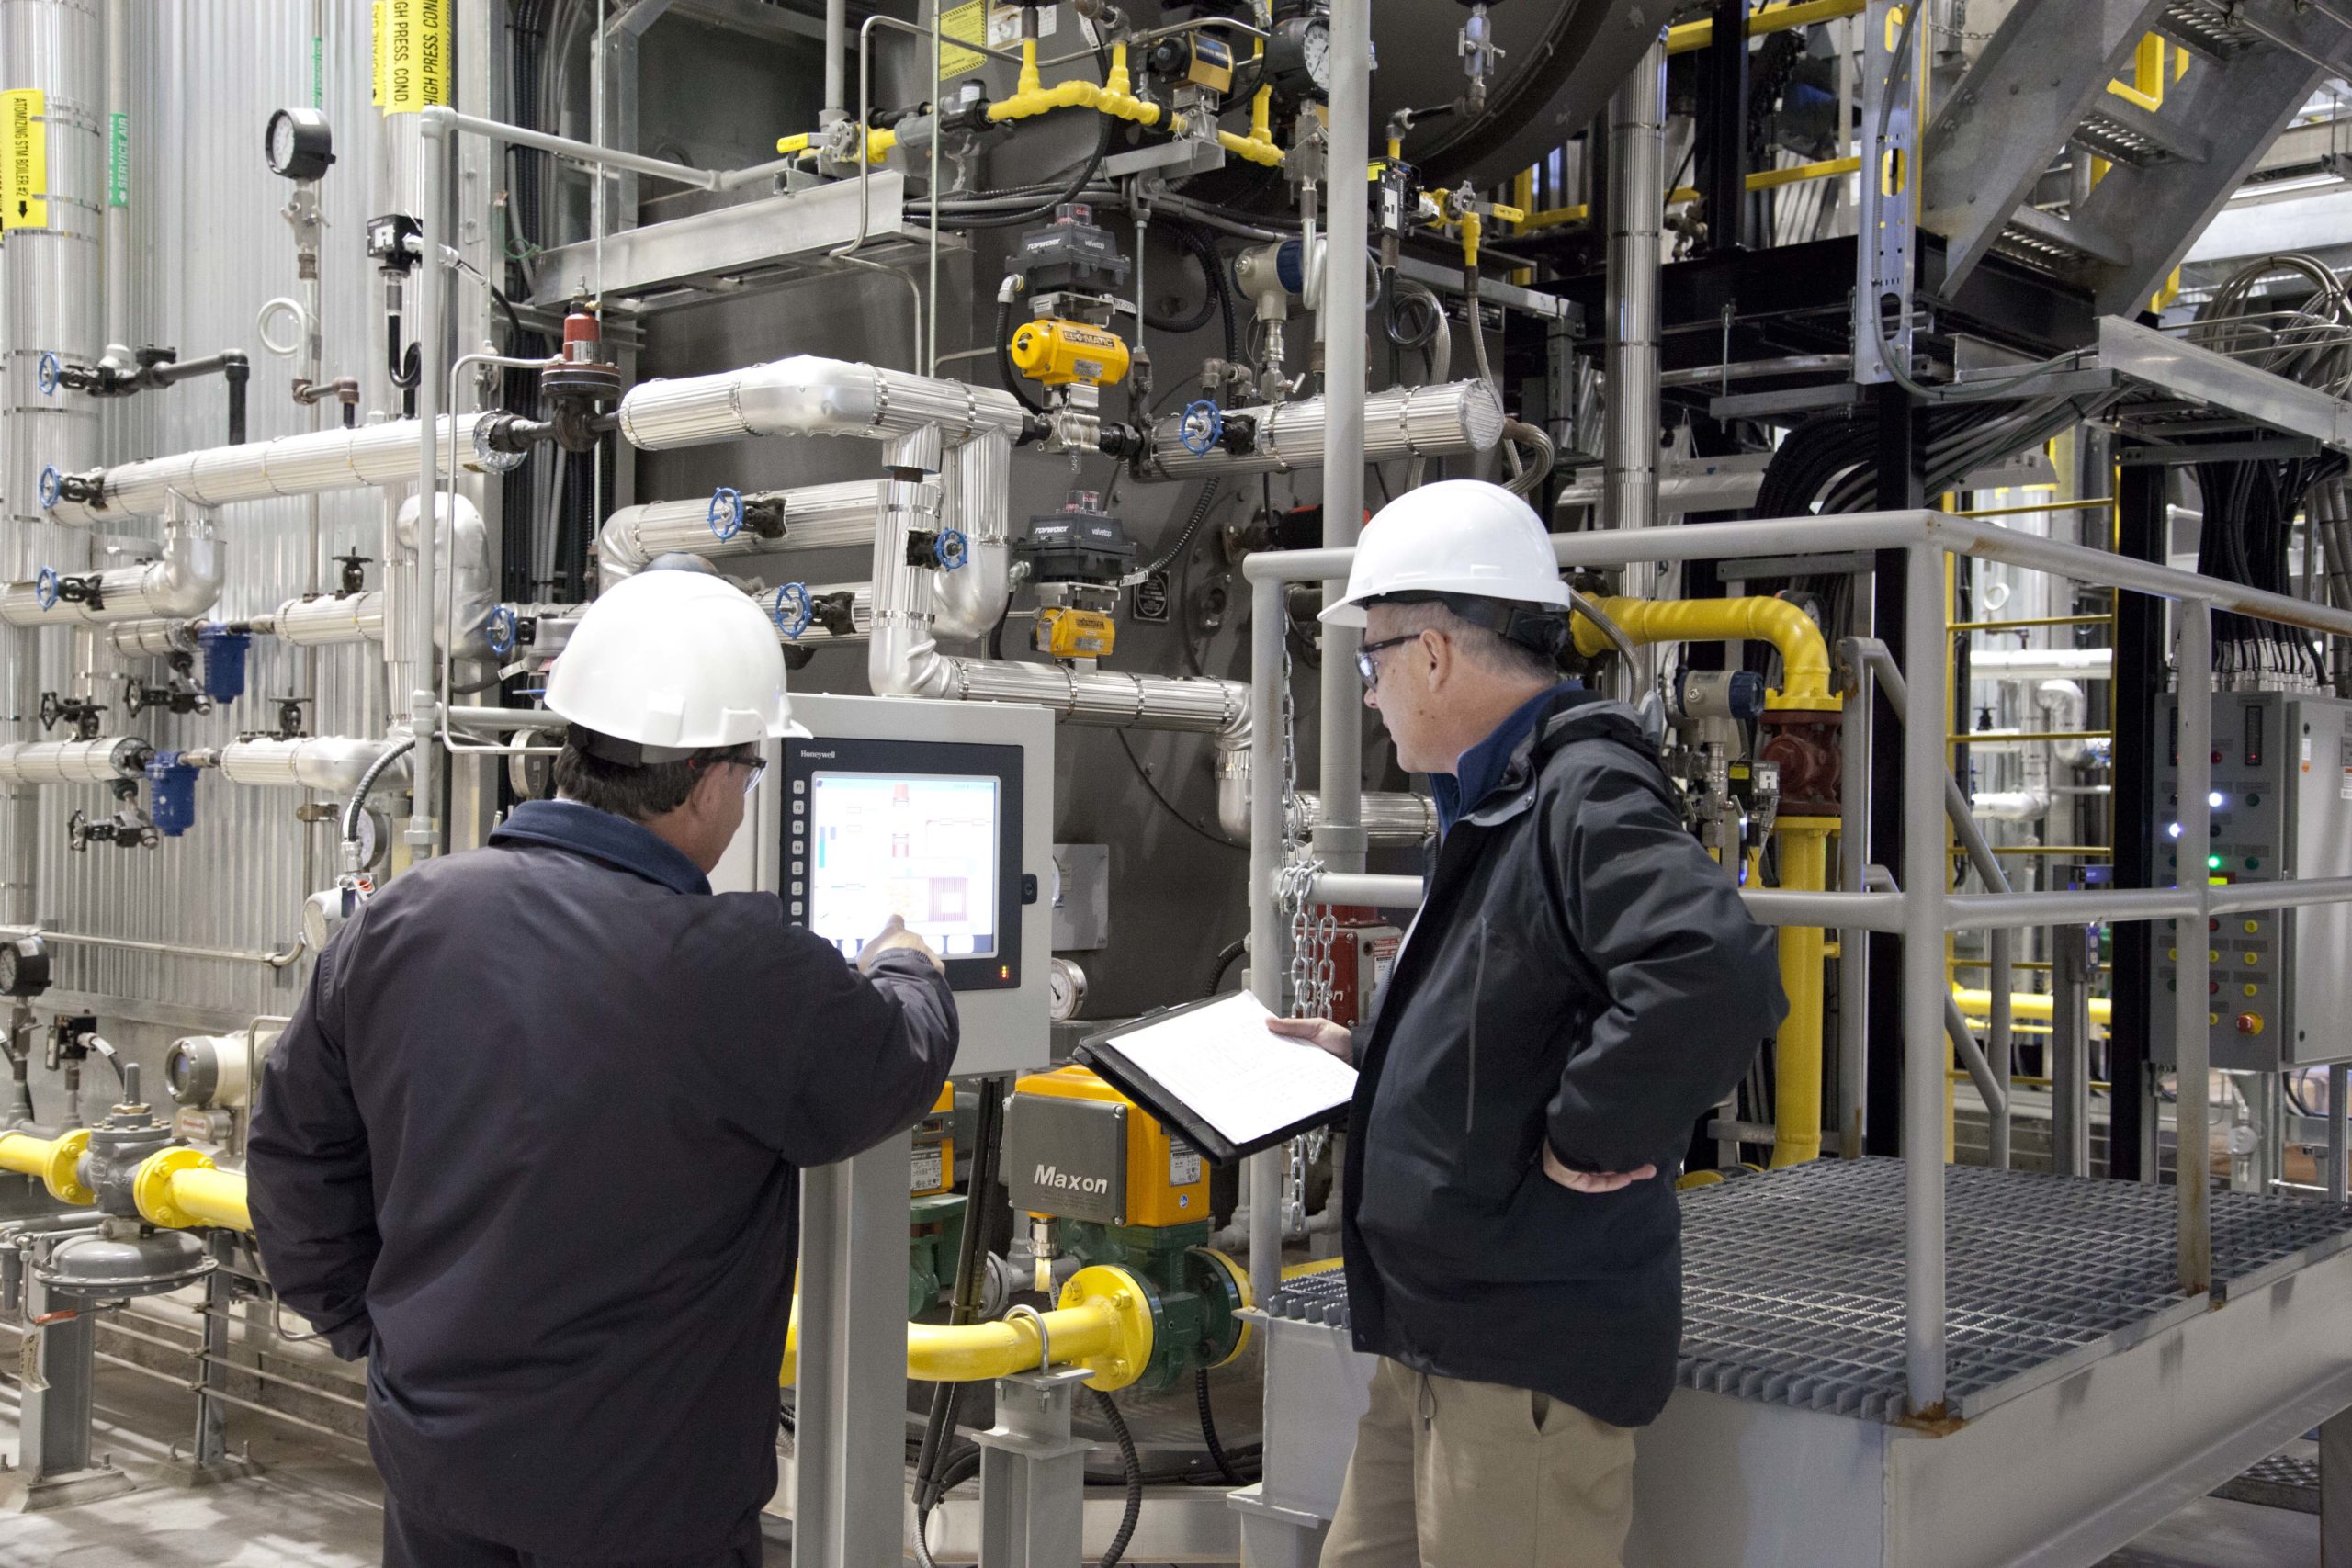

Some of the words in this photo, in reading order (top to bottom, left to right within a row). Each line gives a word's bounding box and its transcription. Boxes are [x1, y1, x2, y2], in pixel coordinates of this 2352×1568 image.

[394, 0, 409, 18] GH
[423, 0, 438, 28] CON
[394, 22, 409, 64] PRESS.
[423, 33, 438, 74] PRESS.
[394, 68, 409, 106] COND.
[14, 97, 28, 139] ATOMIZING
[118, 118, 129, 137] AIR
[15, 140, 28, 157] STM
[15, 158, 28, 185] BOILER
[118, 140, 129, 192] SERVICE
[16, 185, 28, 197] #2
[800, 750, 836, 759] Honeywell
[1034, 1163, 1108, 1195] Maxon
